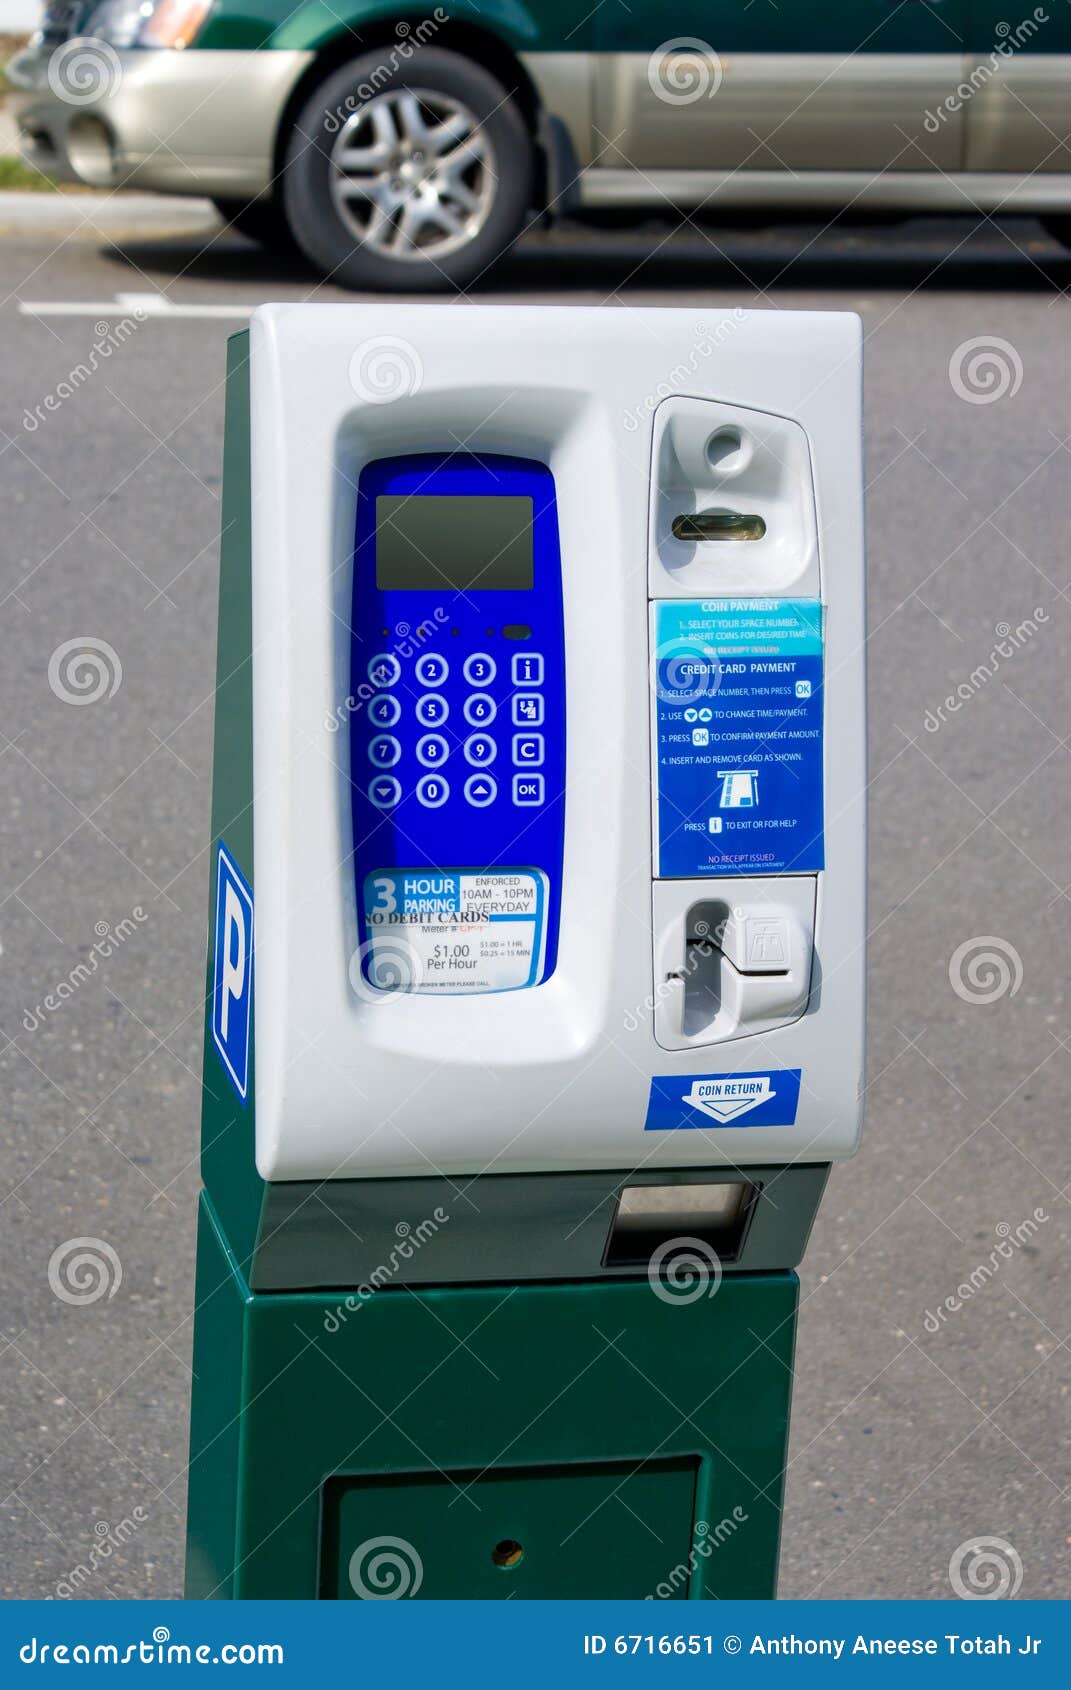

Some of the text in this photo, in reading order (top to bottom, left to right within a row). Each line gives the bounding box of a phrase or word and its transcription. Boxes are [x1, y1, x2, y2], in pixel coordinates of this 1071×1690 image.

[702, 601, 779, 612] COIN PAYMENT
[718, 620, 739, 628] YOUR
[741, 619, 765, 628] SPACE
[716, 631, 740, 640] COINS
[741, 631, 755, 640] FOR
[427, 664, 436, 677] 2
[476, 664, 484, 677] 3
[524, 660, 531, 679] i
[681, 662, 796, 675] CREDIT CARD PAYMENT
[668, 689, 693, 698] SELECT
[695, 688, 717, 697] SPACE
[751, 687, 770, 695] THEN
[771, 686, 792, 695] PRESS
[379, 704, 388, 717] 4
[428, 704, 436, 717] 5
[476, 704, 484, 716] 6
[669, 712, 682, 720] USE
[715, 711, 724, 719] TO
[725, 709, 756, 718] CHANGE
[669, 734, 690, 743] PRESS
[711, 733, 720, 741] TO
[721, 732, 754, 741] CONFIRM
[755, 731, 786, 740] PAYMENT
[379, 745, 388, 757] 7
[428, 745, 436, 756] 8
[476, 744, 484, 756] 9
[521, 742, 535, 757] C
[669, 756, 694, 765] INSERT
[695, 756, 711, 764] AND
[713, 755, 742, 764] REMOVE
[743, 754, 763, 763] CARD
[764, 754, 773, 762] AS
[428, 784, 437, 798] 0
[519, 785, 536, 795] OK
[685, 823, 706, 831] PRESS
[726, 821, 736, 830] TO
[737, 821, 752, 829] EXIT
[753, 820, 763, 828] OR
[764, 820, 778, 828] FOR
[779, 819, 797, 828] HELP
[708, 853, 775, 863] NO RECEIPT ISSUED
[404, 879, 455, 895] HOUR
[476, 877, 520, 886] ENFORCED
[372, 878, 397, 914] 3
[463, 889, 492, 900] 10AM
[504, 888, 533, 899] 10PM
[404, 898, 456, 913] PARKING
[467, 902, 530, 913] EVERYDAY
[365, 911, 489, 924] NO DEBIT CARDS
[422, 925, 449, 933] Meter
[434, 944, 470, 959] $1.00
[221, 879, 245, 1044] P
[427, 959, 477, 969] Per Hour
[699, 1083, 763, 1096] COIN RETURN
